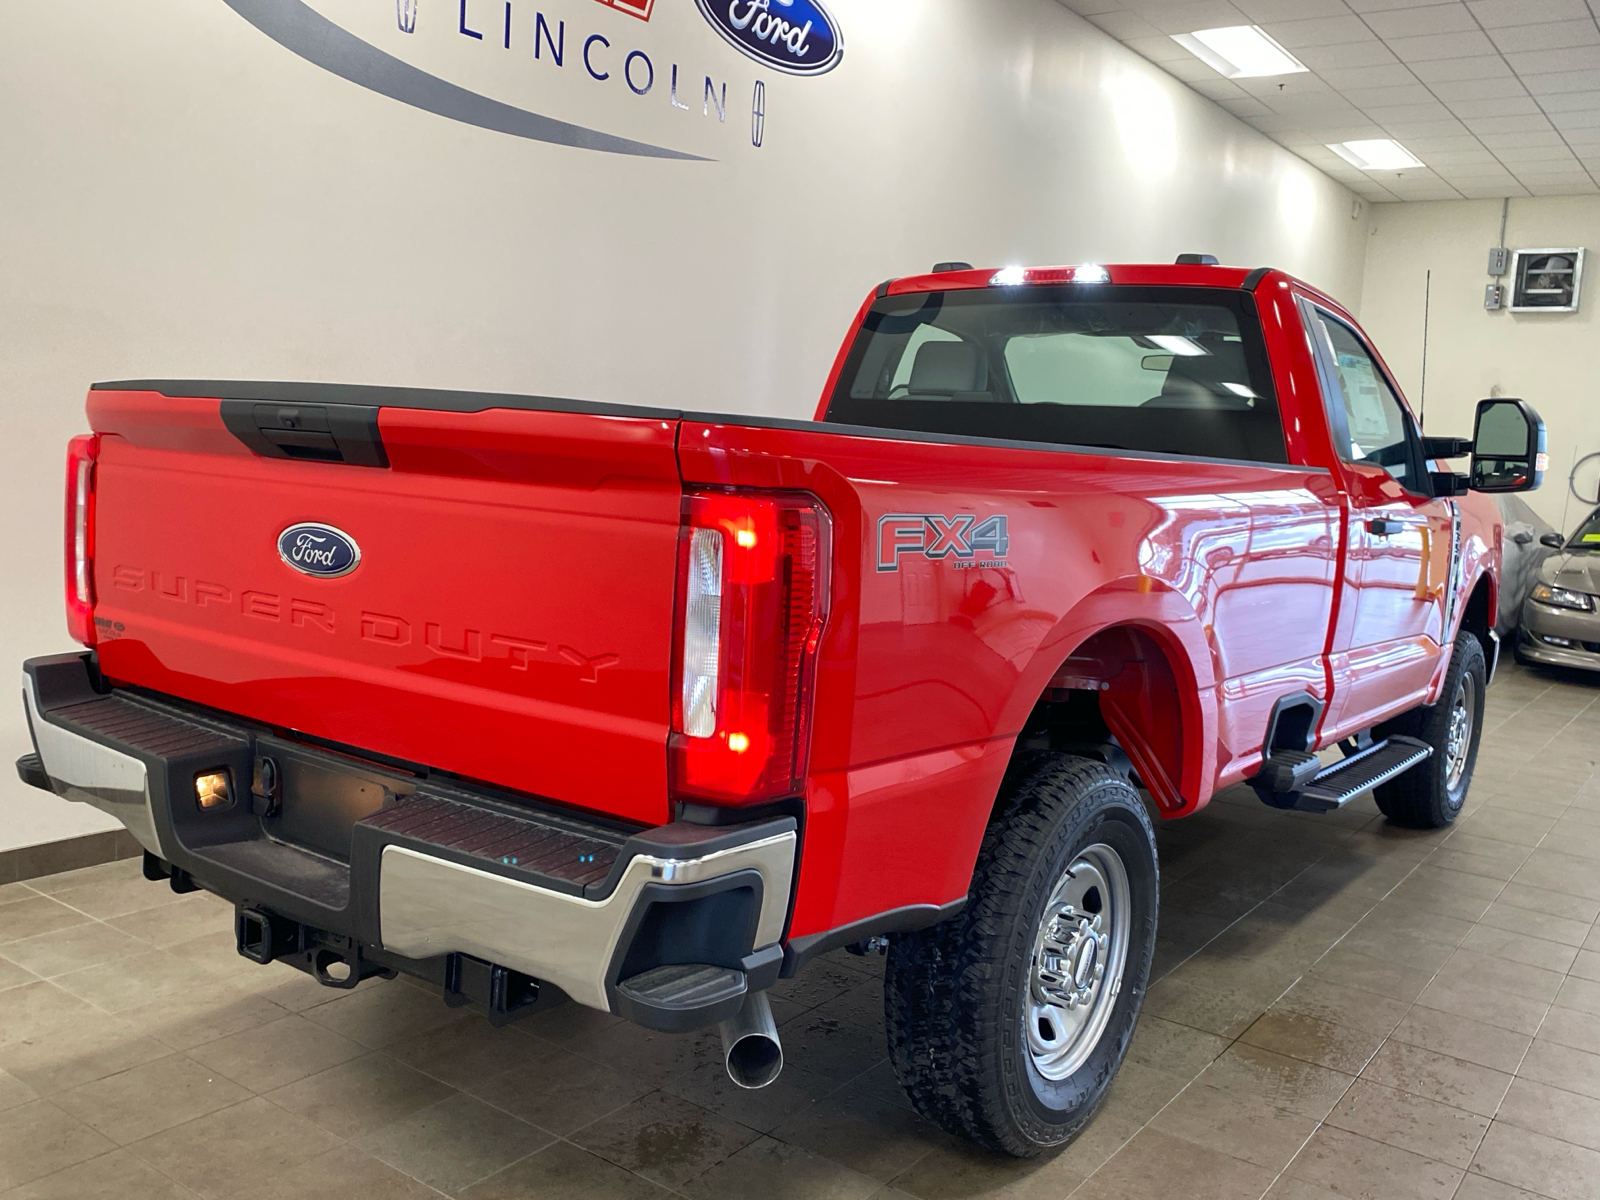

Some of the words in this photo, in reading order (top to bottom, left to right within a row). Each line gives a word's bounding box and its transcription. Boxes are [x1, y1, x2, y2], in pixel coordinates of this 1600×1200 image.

[459, 0, 727, 123] LINCOLN
[292, 532, 337, 567] Ford
[876, 514, 1009, 573] FX4
[953, 561, 975, 569] OFF
[979, 560, 1007, 568] ROAD
[113, 564, 336, 634] SUPER
[360, 611, 619, 682] DUTY
